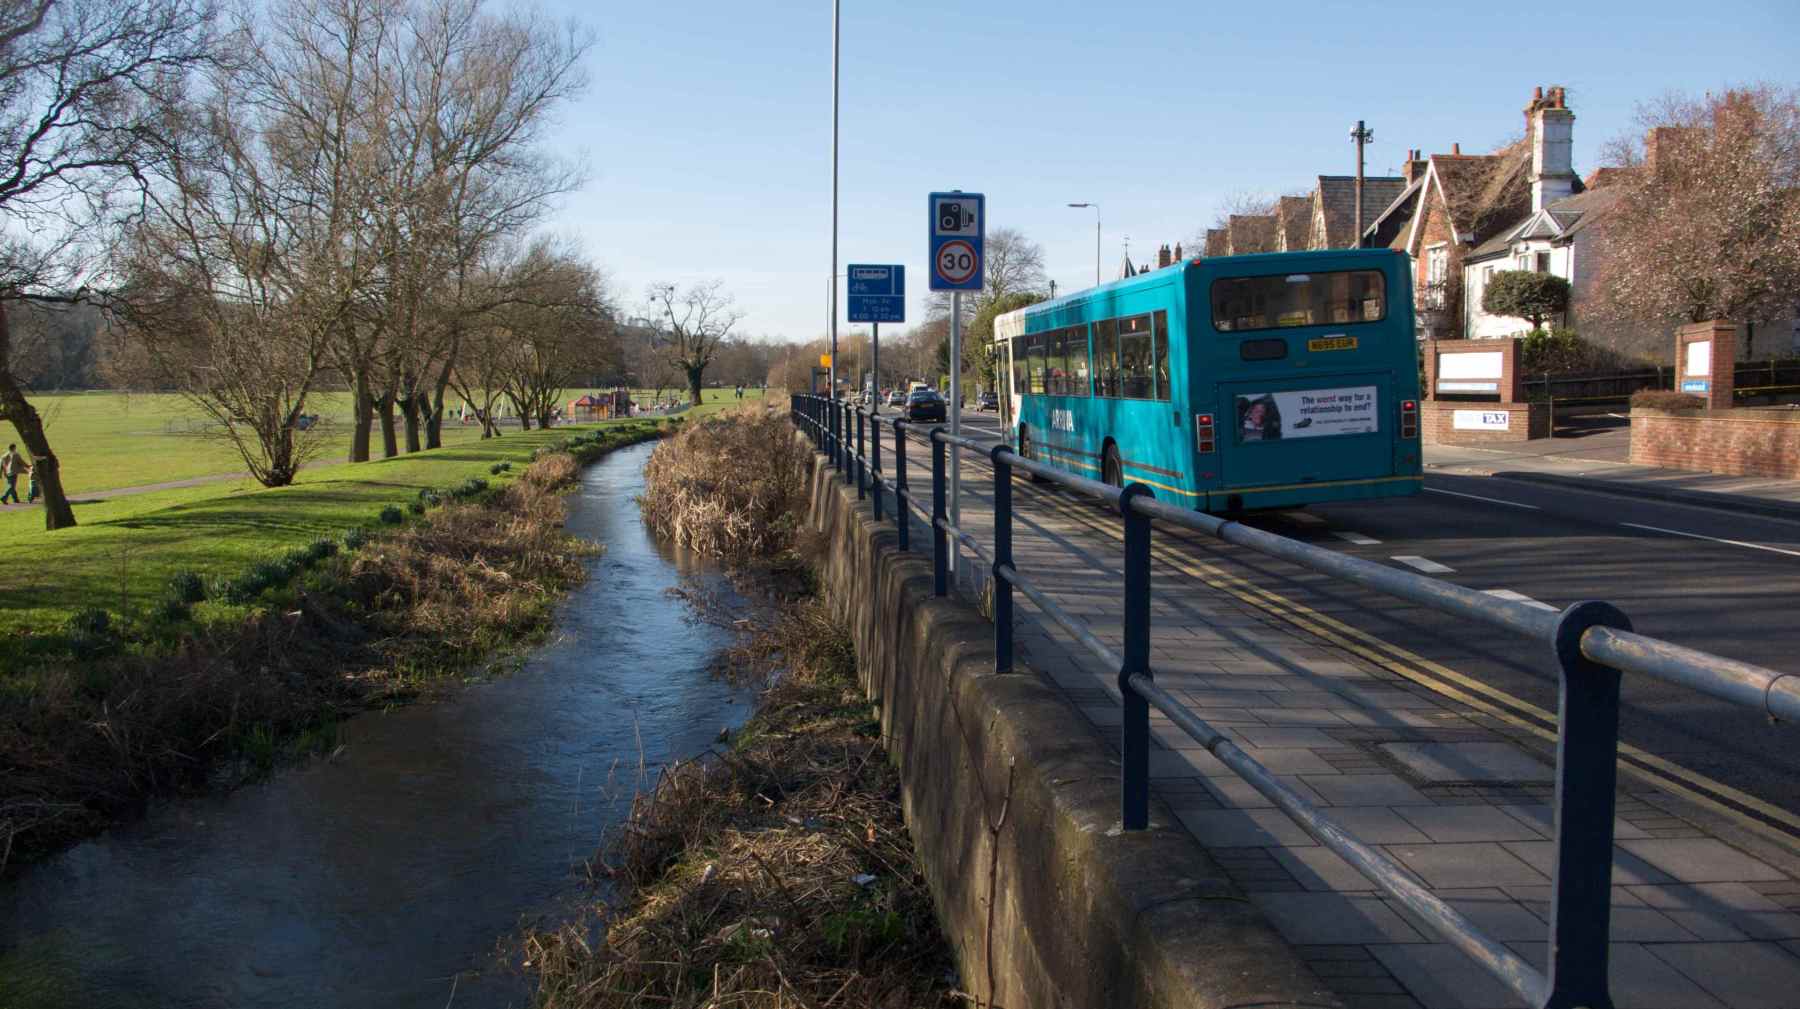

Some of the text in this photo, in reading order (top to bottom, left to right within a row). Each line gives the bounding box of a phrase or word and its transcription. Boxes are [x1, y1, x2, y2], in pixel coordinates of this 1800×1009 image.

[943, 253, 972, 270] 30
[1302, 396, 1315, 404] The
[1316, 394, 1336, 403] worst
[1338, 395, 1353, 403] way
[1354, 392, 1365, 401] for
[1300, 405, 1343, 414] relationship
[1353, 402, 1371, 411] end?
[1483, 413, 1507, 424] TAX
